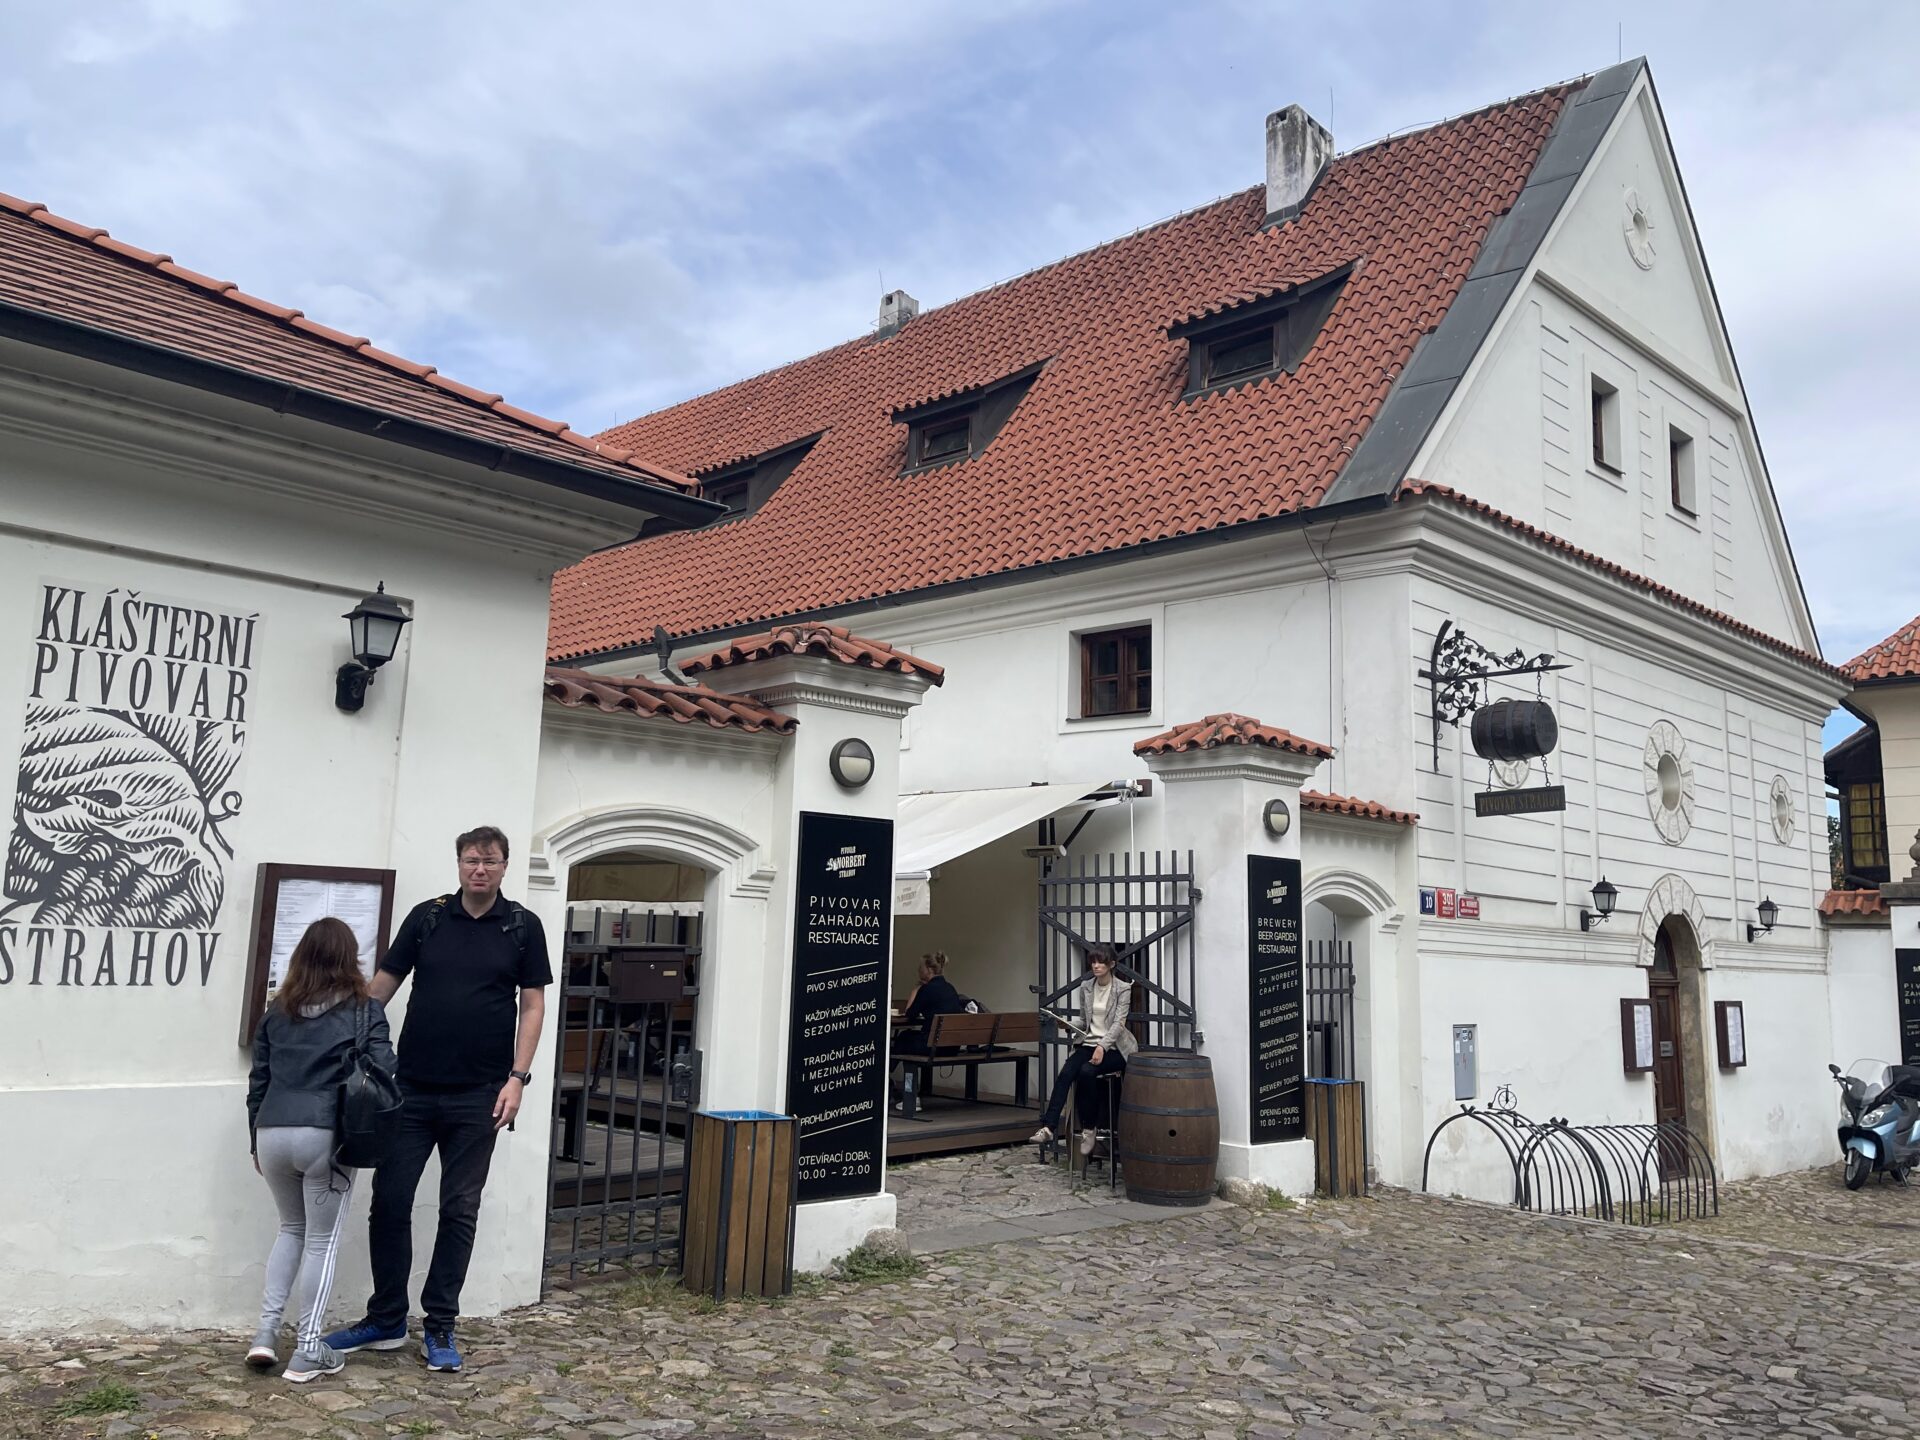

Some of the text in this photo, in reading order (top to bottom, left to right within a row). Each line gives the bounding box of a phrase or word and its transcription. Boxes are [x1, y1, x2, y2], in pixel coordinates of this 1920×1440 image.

[36, 585, 260, 670] KLÁŠTERNÍ
[30, 642, 249, 723] PIVOVAR
[810, 896, 880, 910] PIVOVAR
[1425, 896, 1433, 909] 10
[1442, 892, 1454, 906] 301
[810, 913, 880, 928] ZAHRÁDKA
[1258, 917, 1297, 929] BREWERY
[808, 931, 880, 945] RESTAURACE
[1258, 931, 1297, 942] BEER GARDEN
[0, 926, 221, 987] STRAHOV
[1258, 944, 1297, 955] RESTAURANT
[1271, 968, 1298, 982] NORBERT
[806, 982, 826, 994] PIVO
[841, 972, 878, 987] NORBERT
[1259, 979, 1298, 996] CRAFT BEER
[805, 1007, 831, 1023] KAŽDÝ
[855, 998, 877, 1012] NOVÉ
[1259, 1008, 1272, 1017] NEW
[804, 1014, 877, 1038] SEZONNÍ PIVO
[803, 1040, 876, 1067] TRADIČNÍ ČESKÁ
[809, 1054, 876, 1081] MEZINÁRODNÍ
[1265, 1055, 1294, 1070] CUISINE
[1260, 1080, 1283, 1094] BREWERY
[800, 1100, 874, 1127] PROHLÍDKY PIVOVARU
[1260, 1109, 1282, 1117] OPENING
[798, 1150, 871, 1167] OTEVÍRACÍ DOBA:
[798, 1169, 827, 1180] 10.00
[842, 1164, 871, 1177] 22.00
